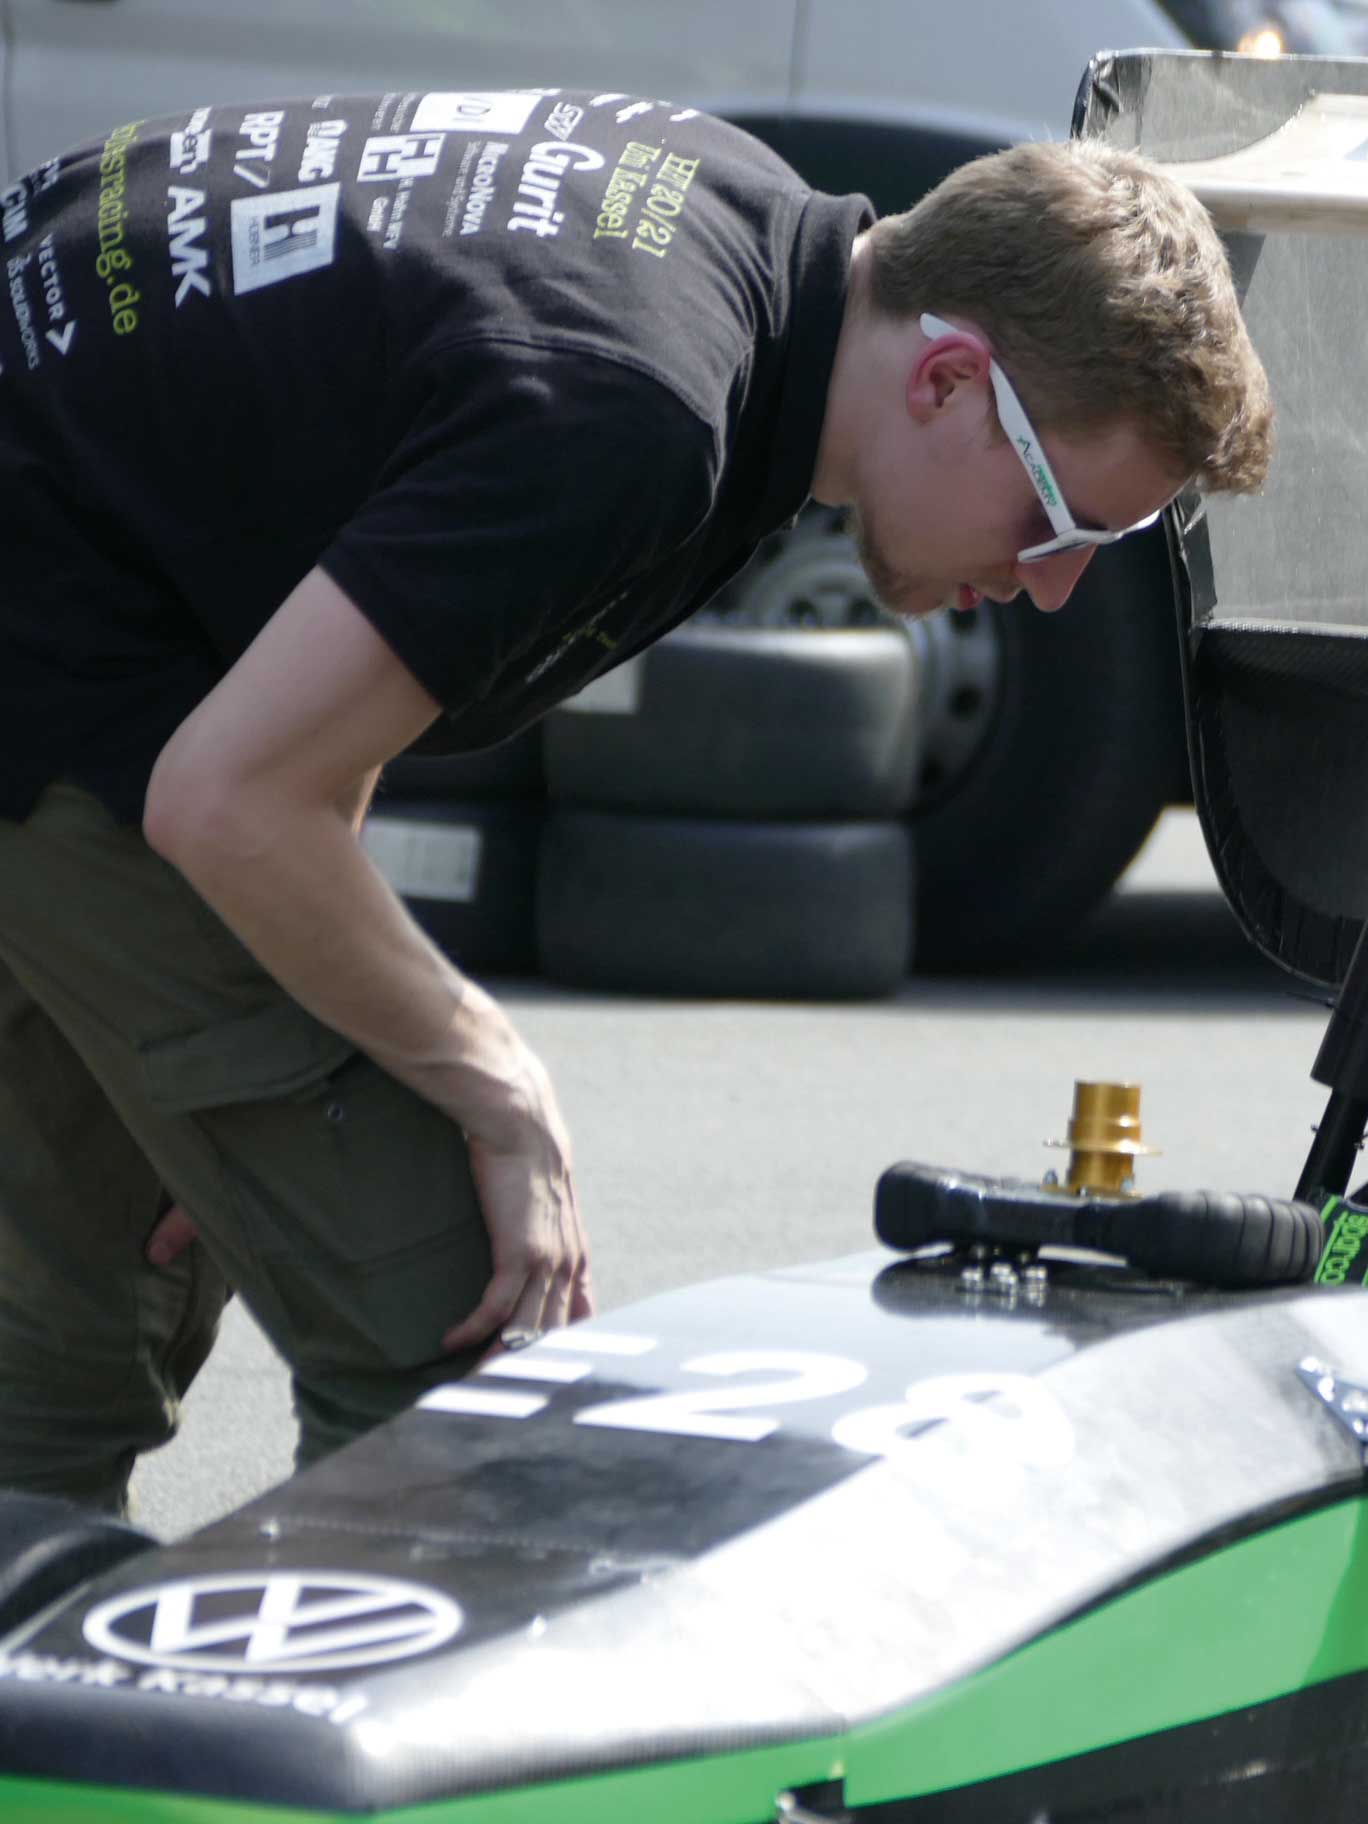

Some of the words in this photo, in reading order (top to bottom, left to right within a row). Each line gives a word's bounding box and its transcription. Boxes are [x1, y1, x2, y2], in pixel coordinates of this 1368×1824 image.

[507, 141, 606, 238] Gurit
[593, 168, 647, 240] Kassel
[631, 186, 684, 258] 20/21
[168, 185, 211, 308] AMK
